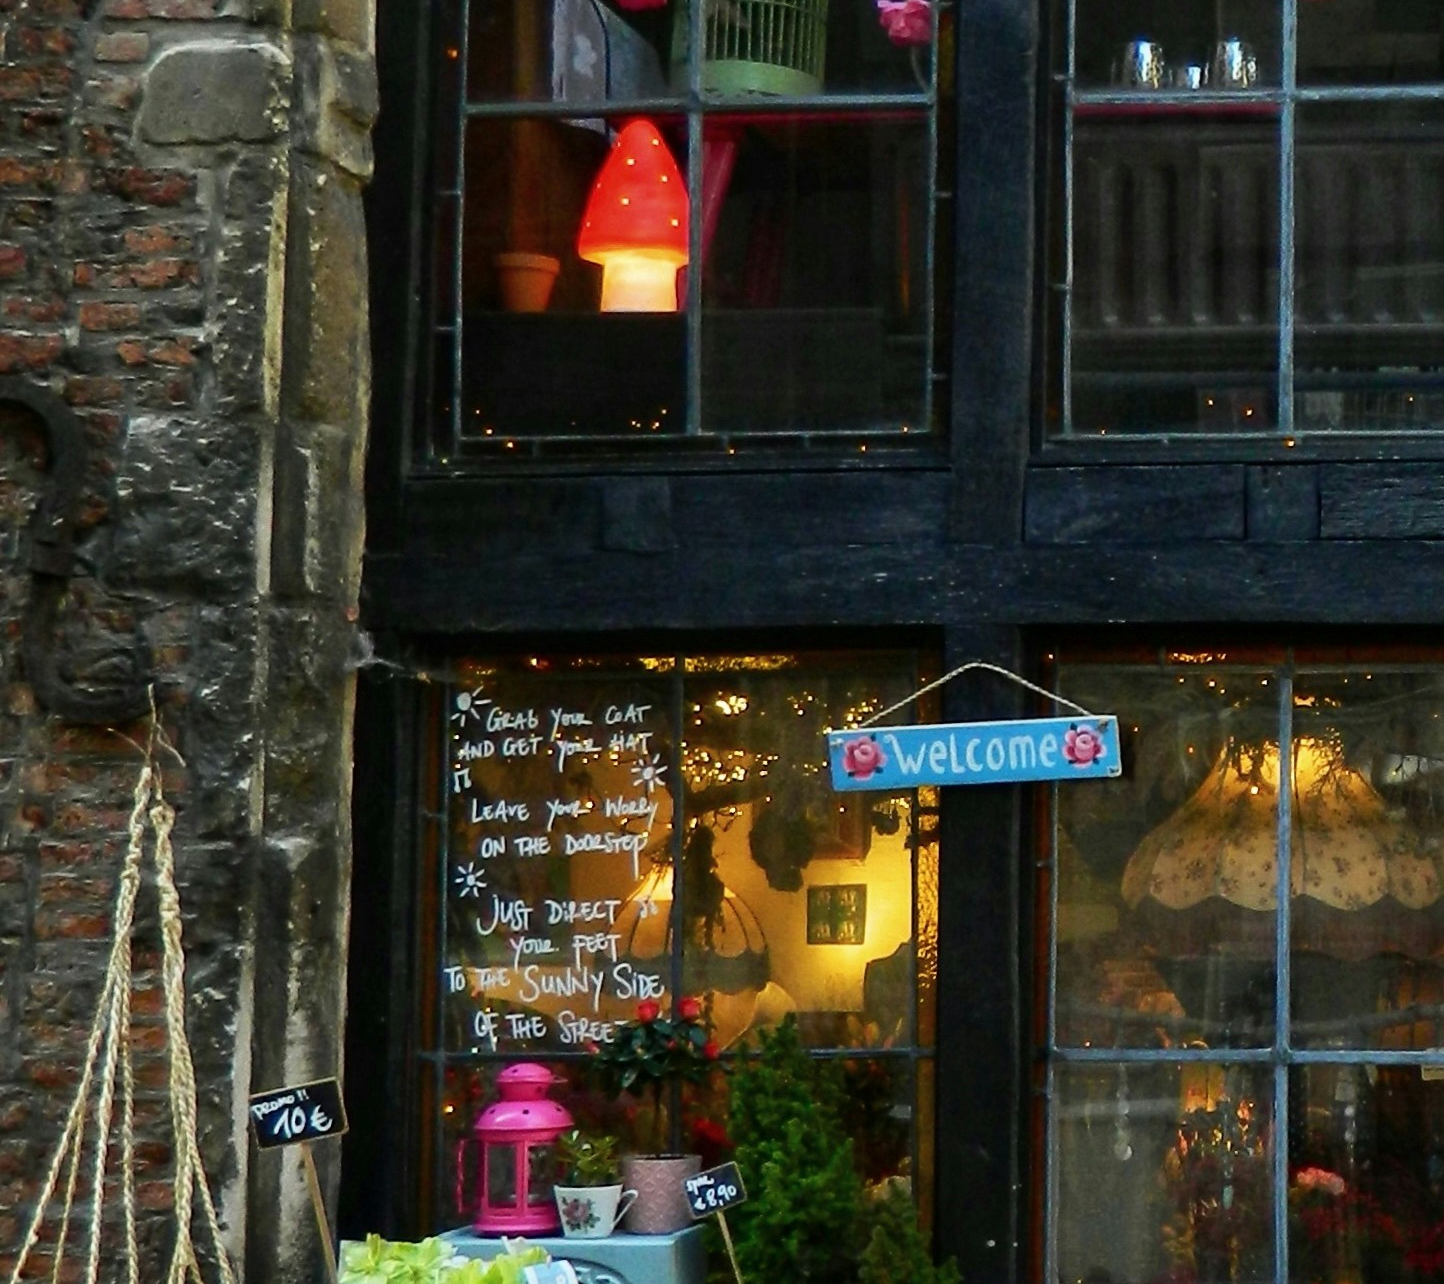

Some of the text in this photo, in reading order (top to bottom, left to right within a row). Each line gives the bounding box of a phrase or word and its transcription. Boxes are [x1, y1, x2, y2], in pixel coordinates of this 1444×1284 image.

[604, 703, 652, 725] COAT
[457, 740, 495, 761] AND
[502, 736, 544, 757] GET
[609, 731, 653, 755] HAT
[471, 797, 531, 823] LEAVE
[481, 835, 507, 859] ON
[513, 836, 551, 857] THE
[476, 893, 534, 936] JUST
[571, 932, 622, 972] FEET
[444, 965, 466, 993] TO
[474, 966, 511, 988] THE
[519, 964, 604, 1013] SUNNY
[474, 1009, 500, 1053] OF
[505, 1013, 547, 1040] THE
